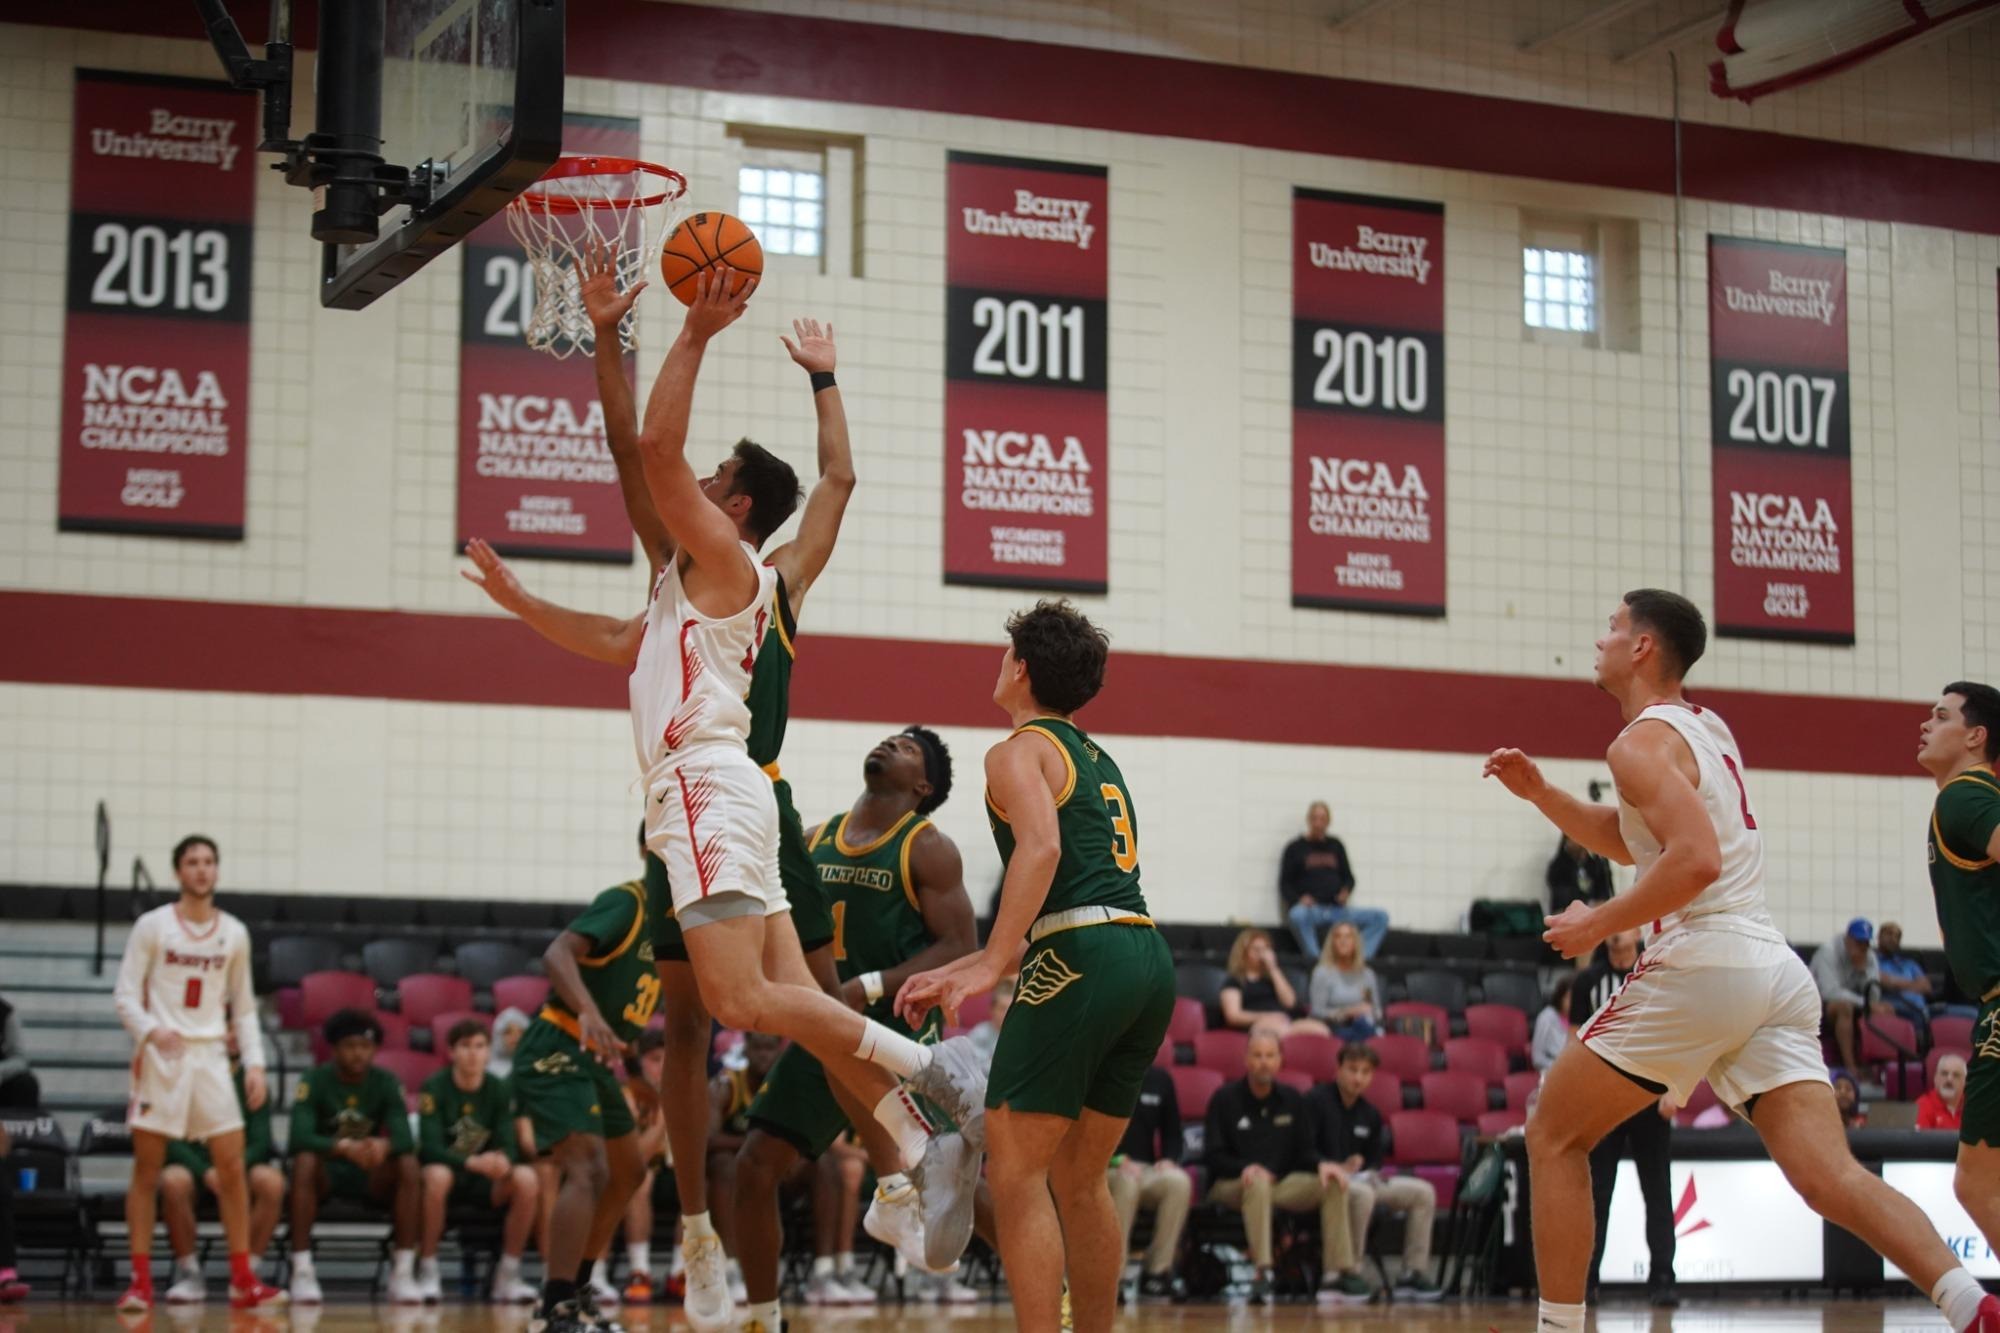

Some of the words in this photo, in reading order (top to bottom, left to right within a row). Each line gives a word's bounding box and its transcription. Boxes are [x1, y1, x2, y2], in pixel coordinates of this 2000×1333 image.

[151, 108, 236, 146] Barry
[91, 128, 240, 171] University
[1014, 189, 1091, 224] Barry
[962, 207, 1095, 249] University
[1357, 225, 1428, 256] Barry
[91, 223, 229, 312] 2013
[1309, 242, 1431, 284] University
[1768, 269, 1831, 299] Barry
[1725, 286, 1836, 326] University
[972, 297, 1085, 382] 2011
[82, 363, 228, 409] NCAA
[1313, 328, 1427, 413] 2010
[82, 403, 229, 434] NATIONAL
[1727, 369, 1837, 448] 2007
[80, 427, 229, 456] CHAMPIONS
[962, 429, 1092, 472] NCAA
[476, 455, 620, 484] CHAMPIONS
[963, 465, 1093, 496] NATIONAL
[1309, 456, 1430, 500] NCAA
[120, 485, 186, 508] GOLF
[961, 488, 1094, 518] CHAMPIONS
[1310, 492, 1431, 523] NATIONAL
[1730, 491, 1839, 533] NCAA
[505, 511, 587, 535] TENNIS
[990, 526, 1065, 544] WOMEN'S
[1308, 514, 1431, 543] CHAMPIONS
[990, 541, 1065, 566] TENNIS
[1731, 525, 1840, 556] NATIONAL
[1347, 551, 1392, 568] MEN'S
[1730, 547, 1841, 574] CHAMPIONS
[1334, 565, 1404, 590] TENNIS
[1763, 596, 1811, 618] GOLF
[1100, 783, 1138, 873] 3
[817, 864, 855, 882] INT
[854, 867, 893, 891] LEO
